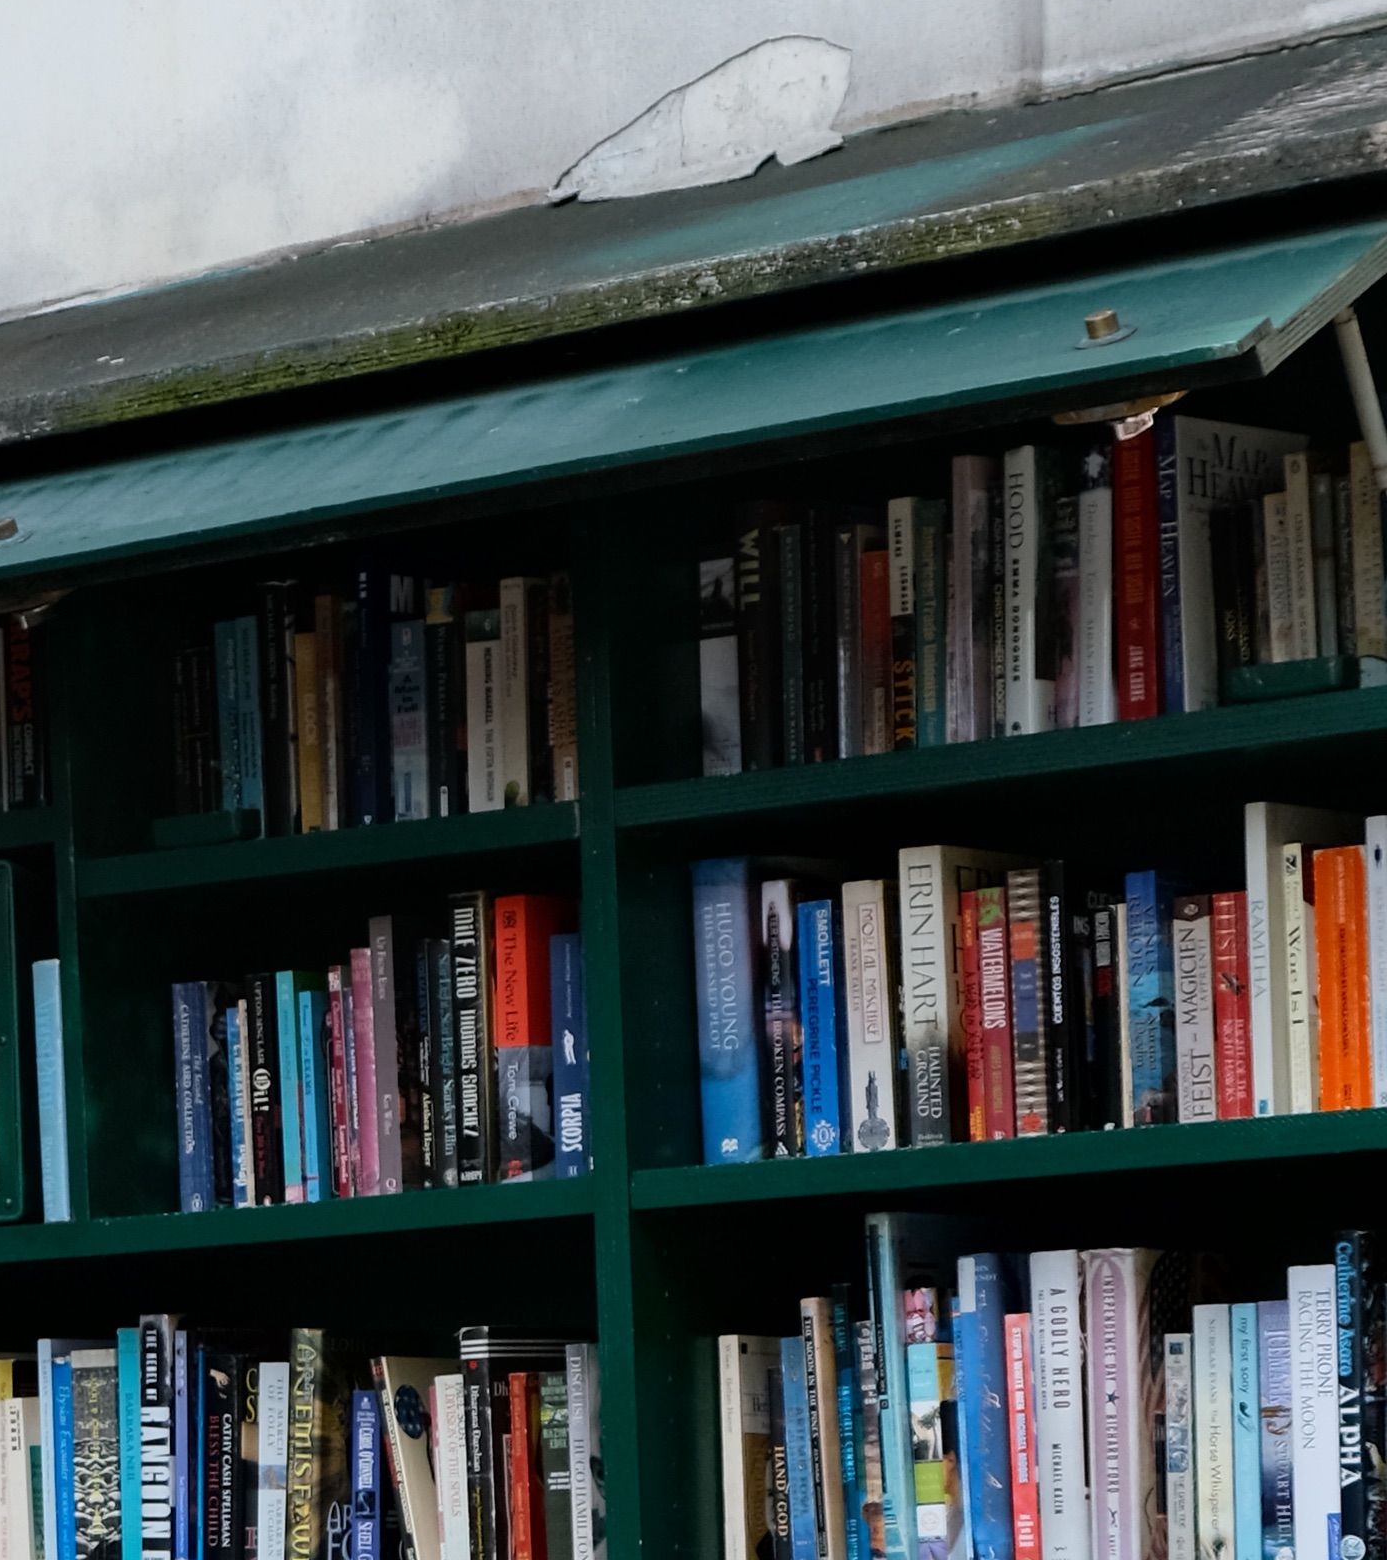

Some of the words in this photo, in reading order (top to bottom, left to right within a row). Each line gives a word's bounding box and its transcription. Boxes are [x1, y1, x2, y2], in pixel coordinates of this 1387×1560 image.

[716, 902, 734, 967] HUGO
[982, 928, 1006, 1029] WATERMELONS
[720, 973, 738, 1051] YOUNG
[1339, 1383, 1361, 1489] ALPHA
